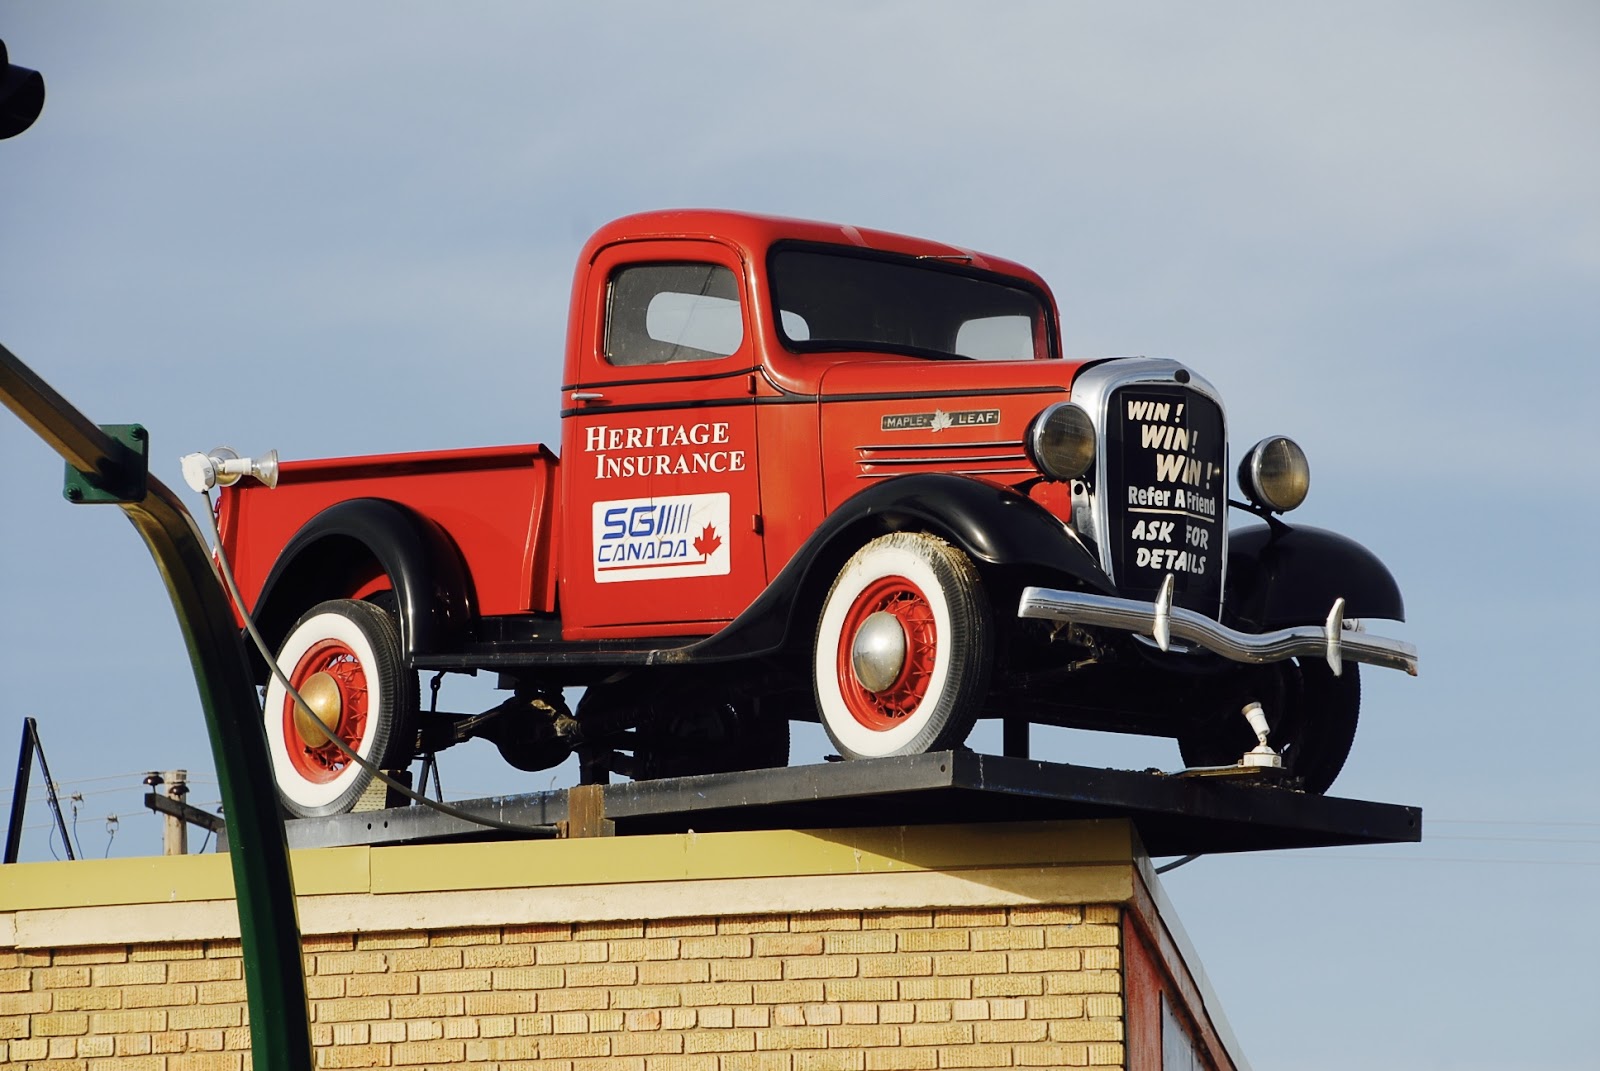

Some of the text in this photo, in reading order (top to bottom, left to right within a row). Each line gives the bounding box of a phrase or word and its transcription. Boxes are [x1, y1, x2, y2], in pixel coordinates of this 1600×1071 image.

[887, 412, 994, 427] MAPLE LEAF
[1129, 486, 1216, 516] Refer A Friend
[1132, 520, 1209, 550] ASK FOR
[598, 539, 688, 563] CANADA
[1136, 548, 1206, 575] DETAILS
